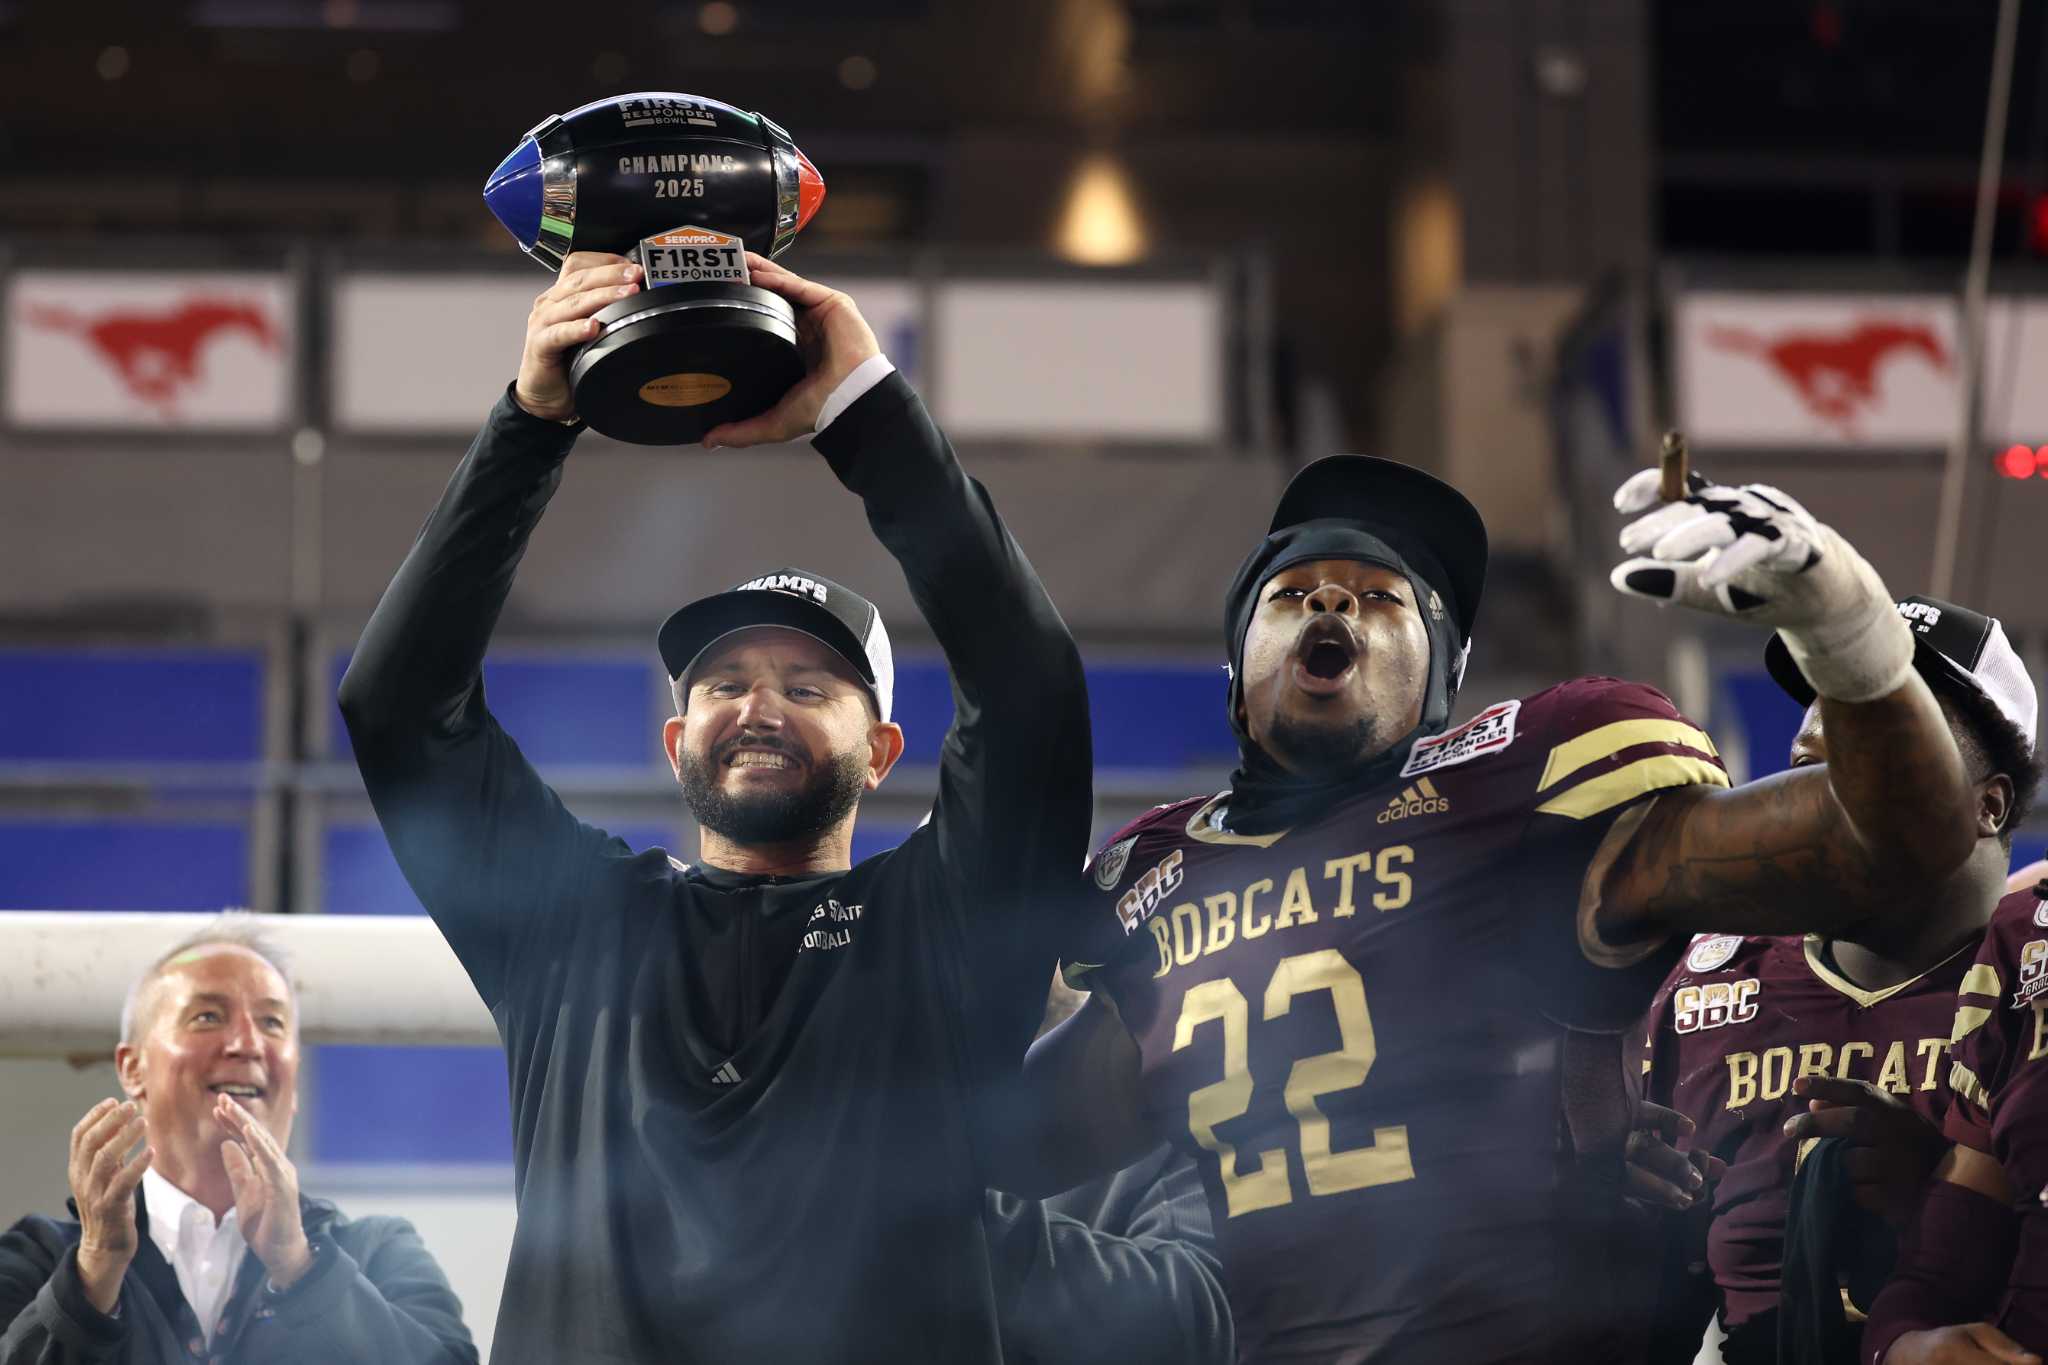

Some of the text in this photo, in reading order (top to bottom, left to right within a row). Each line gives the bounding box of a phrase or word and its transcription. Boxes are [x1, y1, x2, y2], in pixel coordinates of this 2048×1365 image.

[623, 108, 715, 120] RESPONDER
[655, 117, 688, 125] BOWL
[619, 154, 736, 175] CHAMPIONS
[654, 179, 705, 198] 2025
[651, 268, 742, 281] RESPONDER
[1410, 727, 1508, 769] RESPONDER
[1376, 797, 1449, 824] adidas
[1148, 845, 1415, 979] BOBCATS
[1674, 978, 1760, 1035] SBC
[1172, 949, 1415, 1218] 22
[1725, 1038, 1951, 1110] BOBCAT
